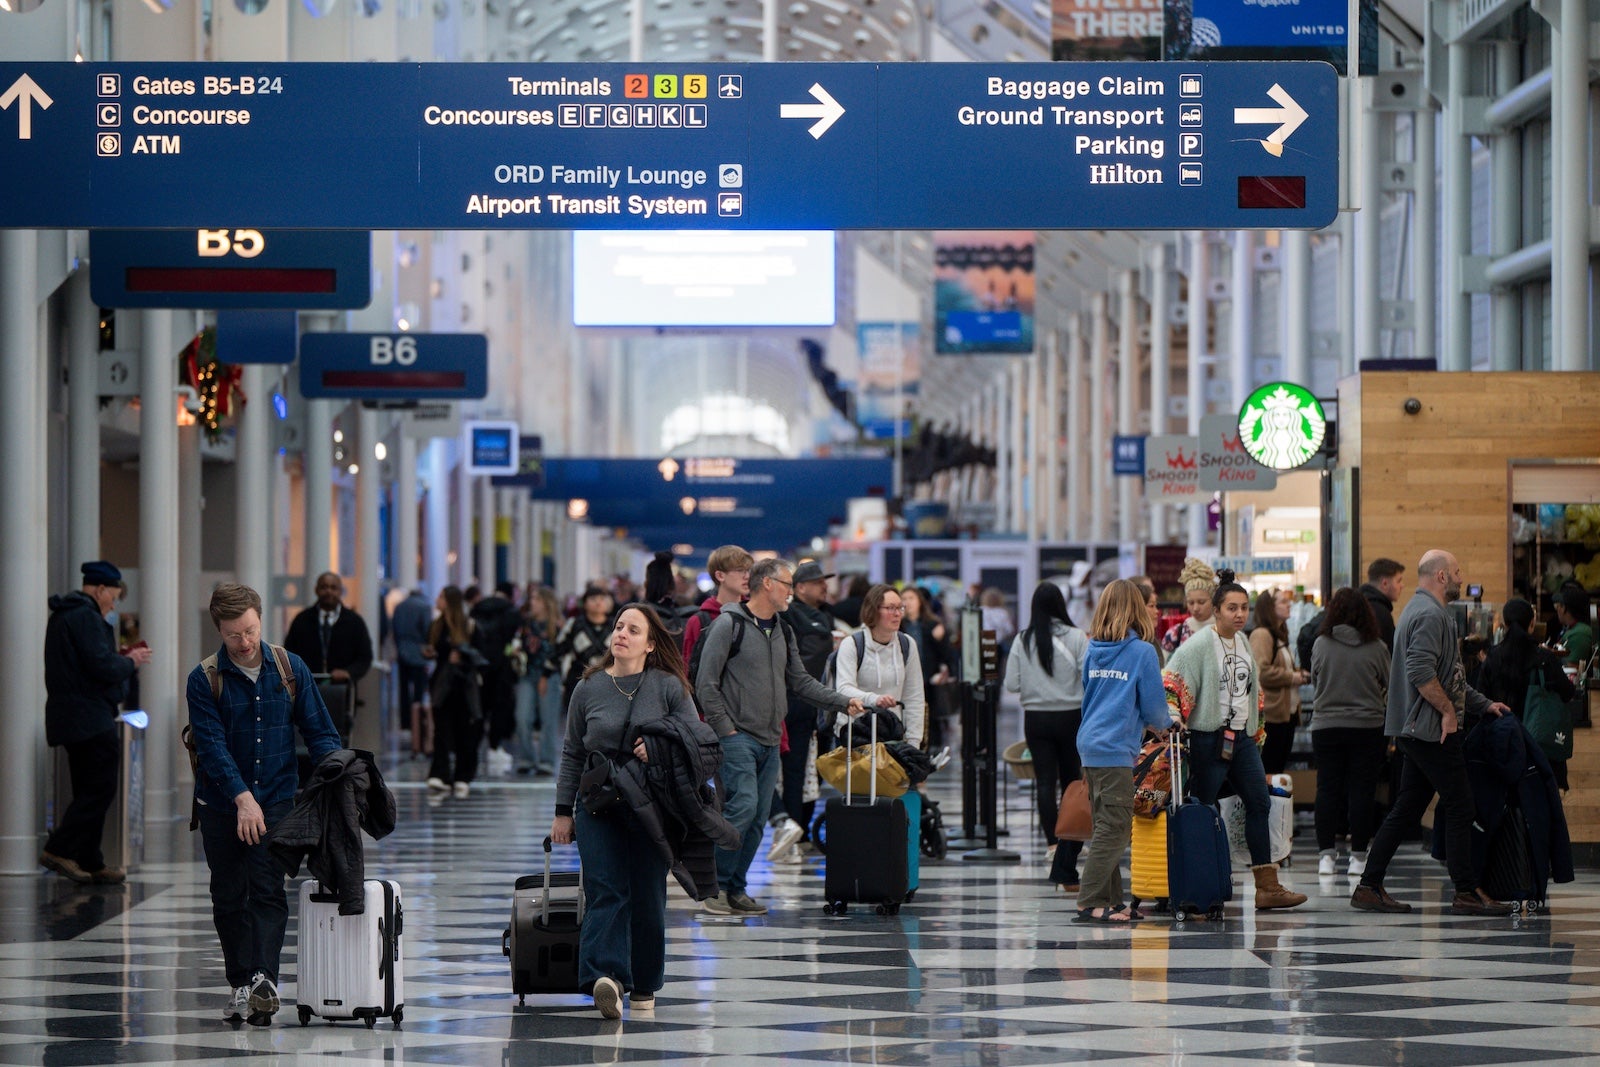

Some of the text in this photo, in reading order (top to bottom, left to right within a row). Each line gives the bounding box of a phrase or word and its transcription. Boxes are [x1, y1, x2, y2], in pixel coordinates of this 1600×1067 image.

[1070, 11, 1163, 37] THERE
[1291, 25, 1345, 35] UNITED
[101, 76, 283, 95] B Gates B5-B24
[508, 77, 701, 95] Terminals 2 3 5
[987, 76, 1164, 99] Baggage Claim
[100, 105, 250, 125] C Concourse
[424, 105, 702, 125] Concourses E F G H K L
[957, 106, 1164, 128] Ground Transport
[132, 135, 181, 154] ATM
[1075, 135, 1165, 158] Parking
[494, 165, 707, 189] ORD Family Lounge
[1090, 163, 1163, 184] Hilton
[466, 195, 707, 218] Airport Transit System
[197, 228, 265, 259] B5
[370, 336, 418, 366] B6
[1200, 453, 1257, 467] SMOOT
[1251, 559, 1294, 572] SNACKS
